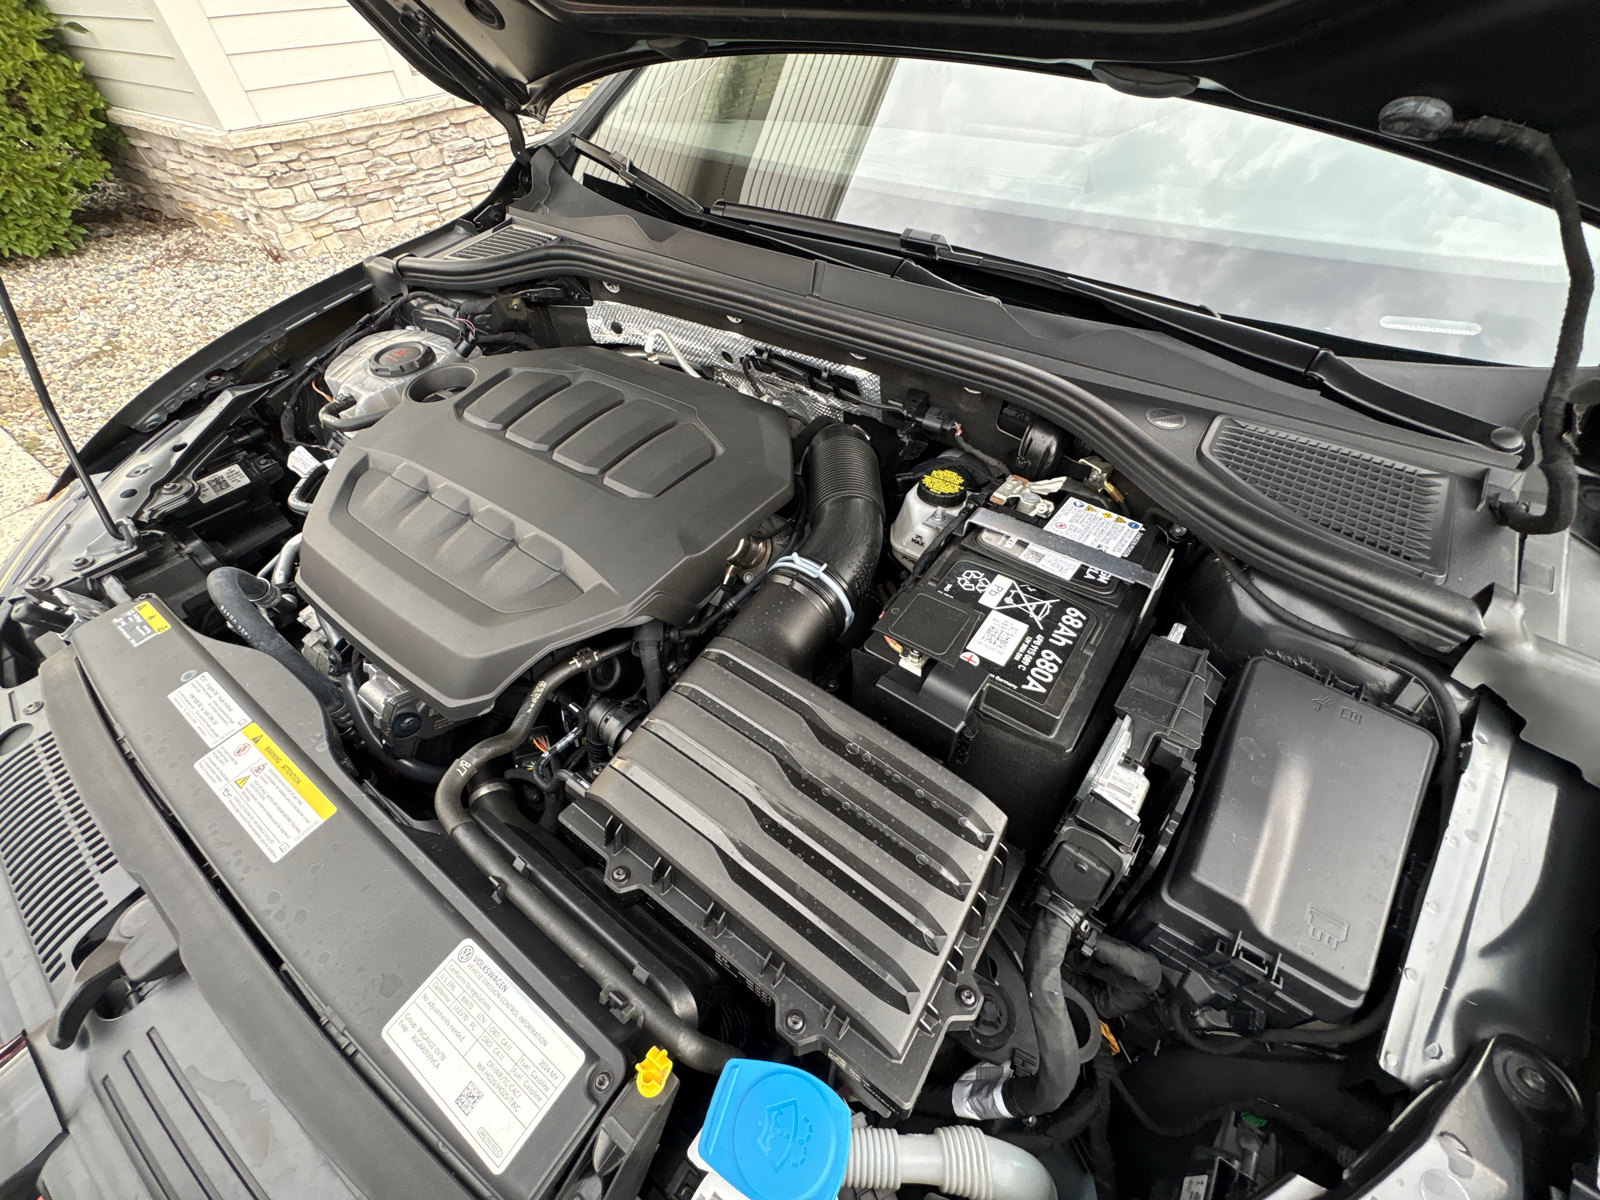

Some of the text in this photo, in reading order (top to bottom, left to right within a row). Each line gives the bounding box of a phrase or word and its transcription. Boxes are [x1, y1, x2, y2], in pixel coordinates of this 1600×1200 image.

[911, 537, 925, 548] MAX
[989, 584, 1003, 596] Pb
[1049, 607, 1086, 646] 68Ah
[1027, 645, 1038, 655] 915
[1022, 649, 1062, 692] 680A
[995, 676, 1017, 689] Germany
[263, 745, 282, 764] WARNING
[280, 764, 302, 785] ATTENTION
[448, 964, 466, 984] Conforms
[473, 955, 508, 992] VOLKSWAGEN
[422, 993, 429, 1001] No
[427, 1000, 450, 1026] adjustments
[461, 995, 487, 1023] BIN70 LDV
[467, 962, 548, 1046] VEHICLE EMISSION CONTROL INFORMATION
[453, 1004, 477, 1030] ULEV70 PC
[492, 1047, 500, 1057] CA
[500, 1038, 508, 1047] CA
[538, 1059, 559, 1080] 2024 MY
[523, 1080, 542, 1102] Gasoline
[530, 1070, 549, 1092] Gasoline
